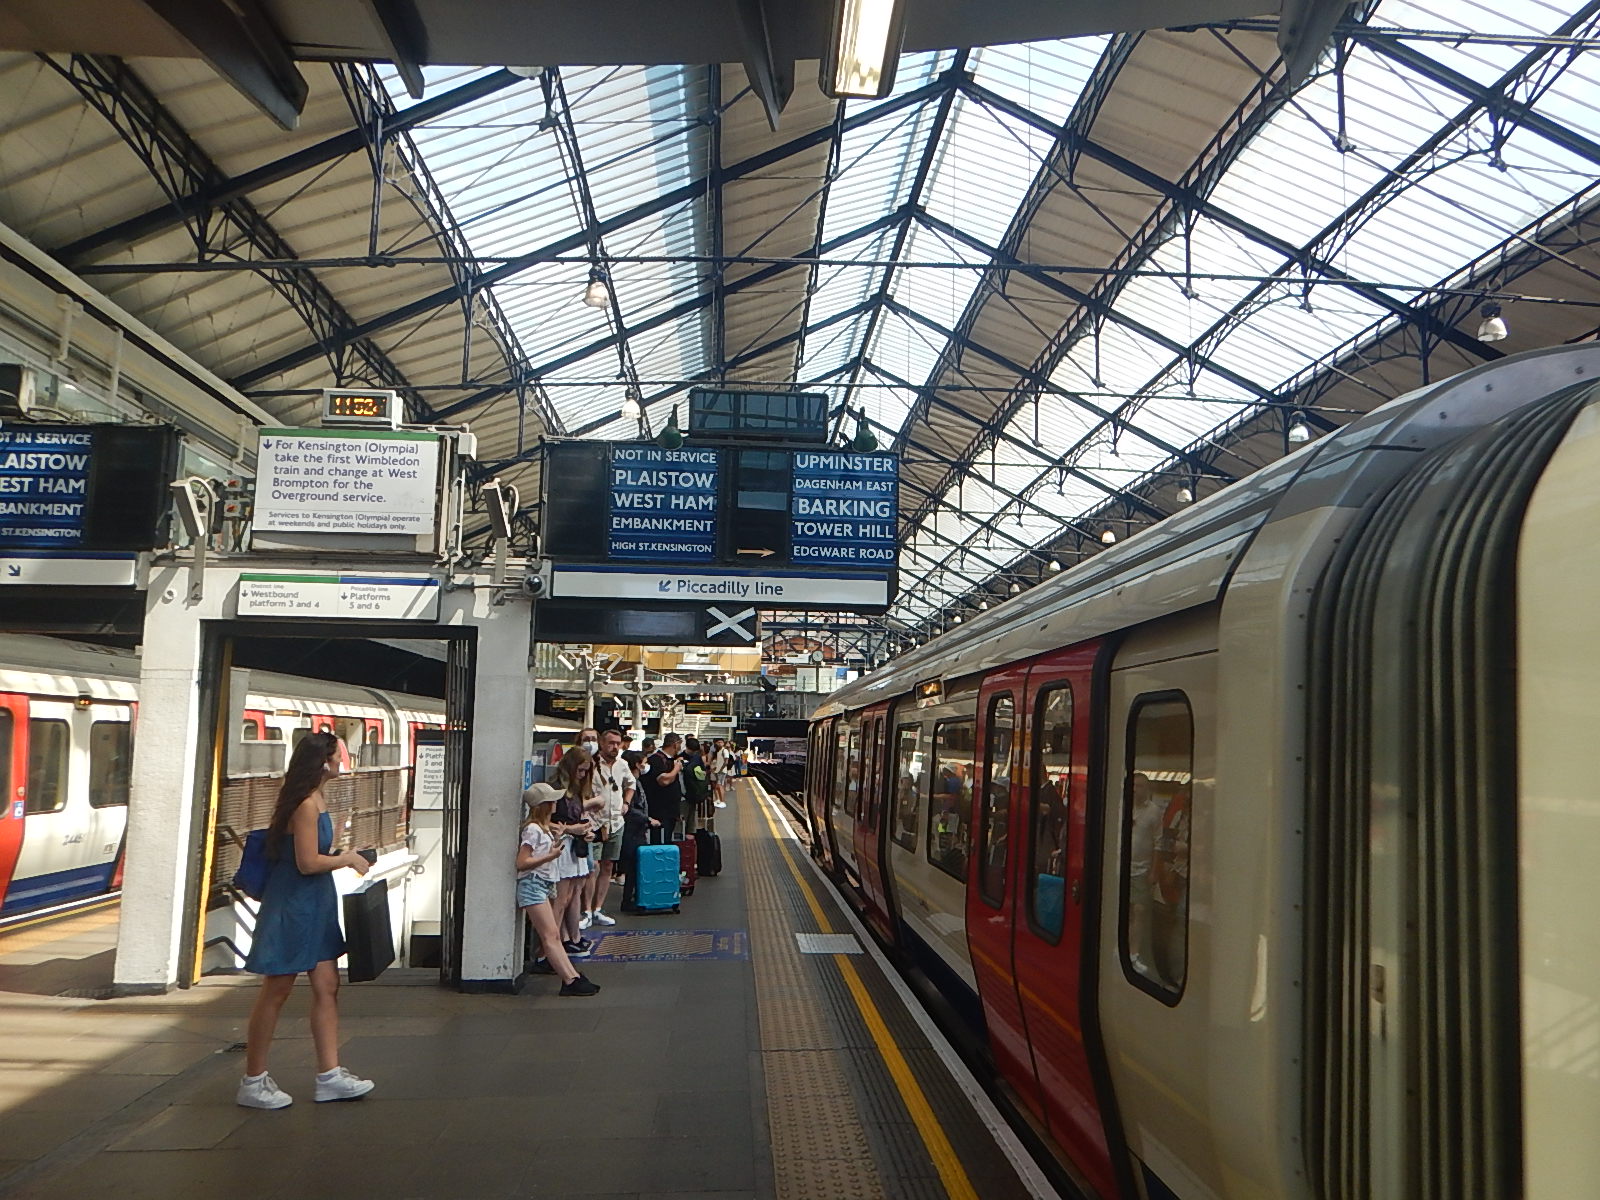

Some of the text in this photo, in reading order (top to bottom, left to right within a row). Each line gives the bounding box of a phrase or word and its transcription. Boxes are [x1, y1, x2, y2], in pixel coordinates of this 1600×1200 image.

[15, 432, 32, 443] IN
[35, 432, 92, 445] SERVICE
[275, 440, 419, 455] For Kensington (Olympia)
[274, 453, 420, 466] take the first Wimbledon
[614, 449, 717, 464] NOT IN SERVICE
[796, 454, 894, 472] UPMINSTER
[273, 465, 418, 479] train and change at West
[615, 469, 714, 488] PLAISTOW
[38, 478, 86, 494] HAM
[272, 478, 373, 490] Brompton for the
[795, 479, 894, 492] DAGENHAM EAST
[271, 489, 387, 503] Overground service.
[614, 492, 714, 511] WEST HAM
[798, 498, 890, 517] BARKING
[268, 511, 300, 519] Services
[312, 512, 353, 521] Kensington
[355, 514, 391, 522] (Olympia)
[332, 521, 355, 529] public
[357, 522, 388, 530] holidays
[612, 517, 714, 532] EMBANKMENT
[794, 522, 894, 538] TOWER HILL
[611, 541, 636, 550] HIGH
[793, 545, 894, 560] EDGWARE ROAD
[250, 590, 300, 599] Westbound
[676, 579, 784, 597] Piccadilly line
[350, 592, 391, 601] Platforms
[249, 600, 287, 608] platform
[288, 600, 294, 608] 3
[357, 602, 372, 610] and
[374, 602, 380, 610] 6
